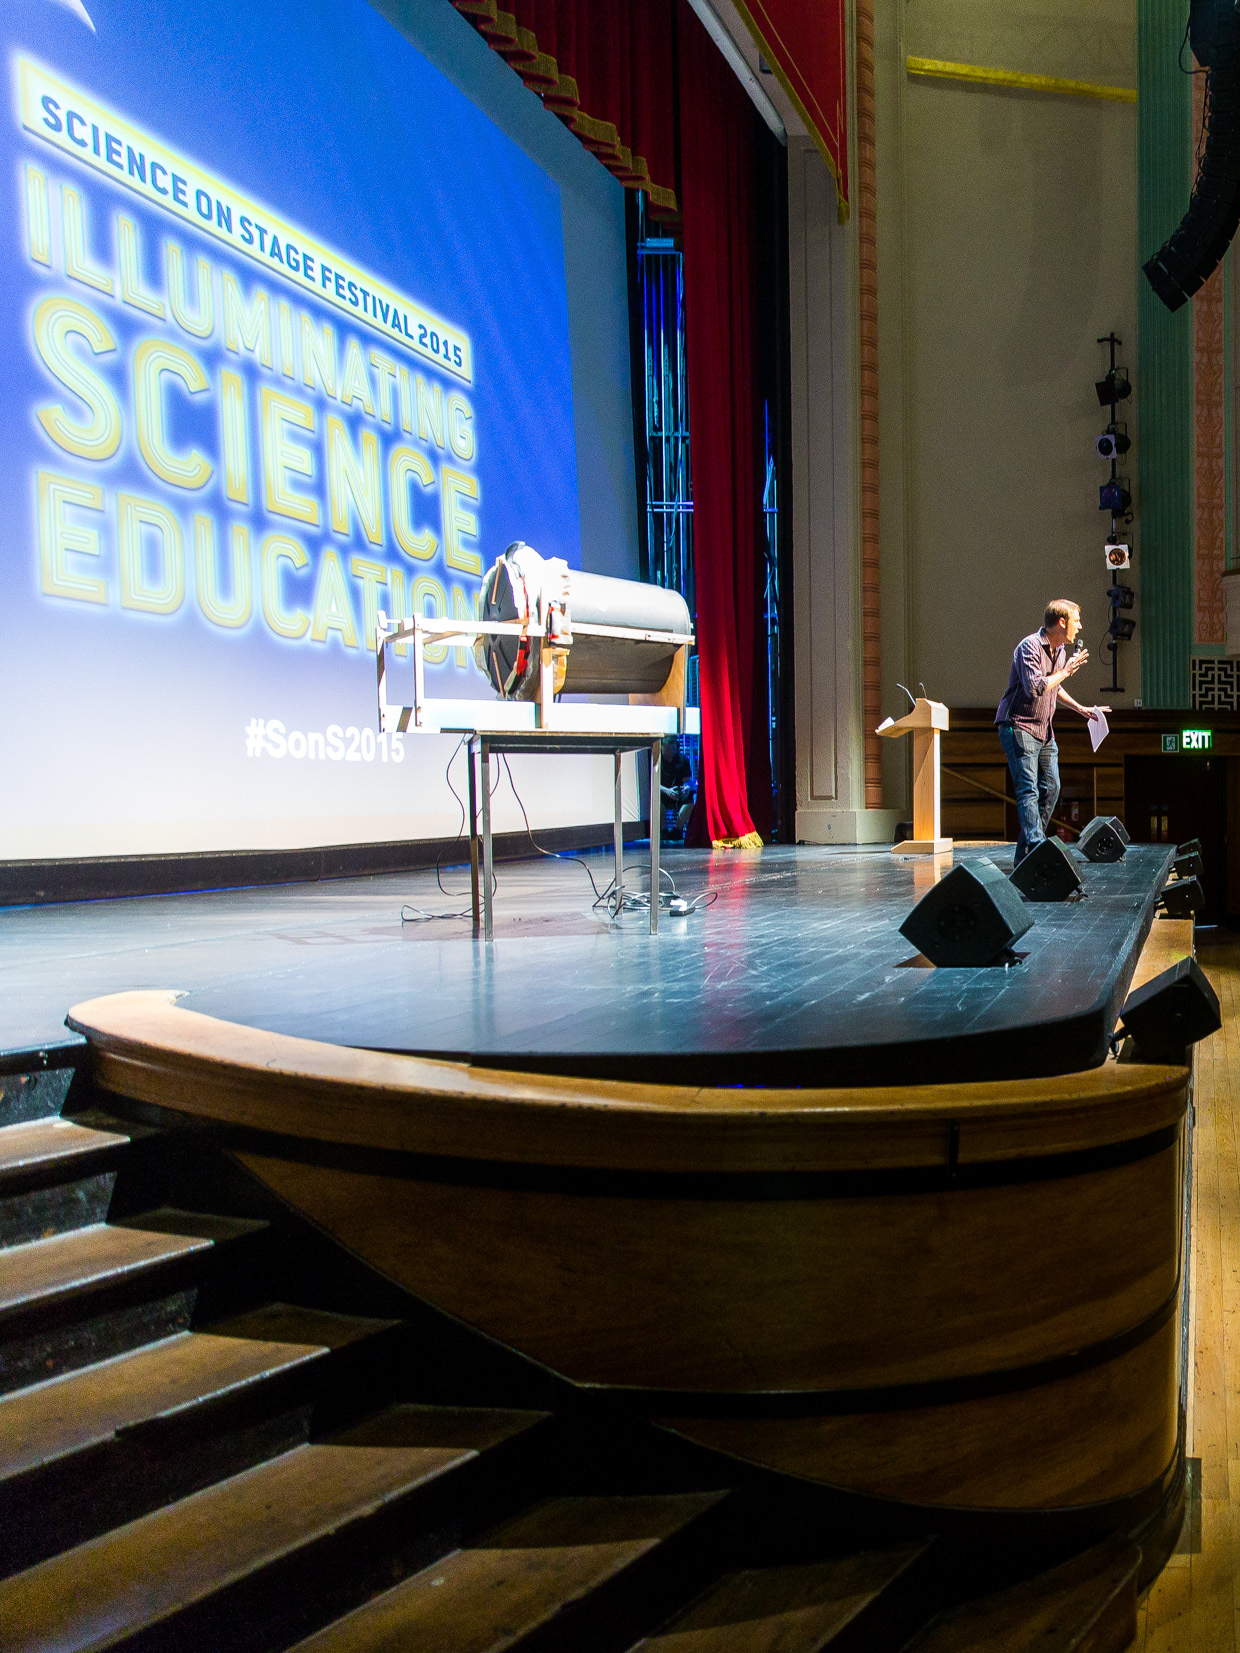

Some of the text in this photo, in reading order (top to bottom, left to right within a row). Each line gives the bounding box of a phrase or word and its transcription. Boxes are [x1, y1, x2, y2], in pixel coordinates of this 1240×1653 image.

[26, 165, 475, 461] ILLUMINATING
[41, 94, 463, 368] SCIENCE ON STAGE FESTIVAL 2015
[33, 296, 482, 577] SCIENCE
[244, 717, 405, 764] #SonS2015
[1182, 730, 1211, 749] EXIT
